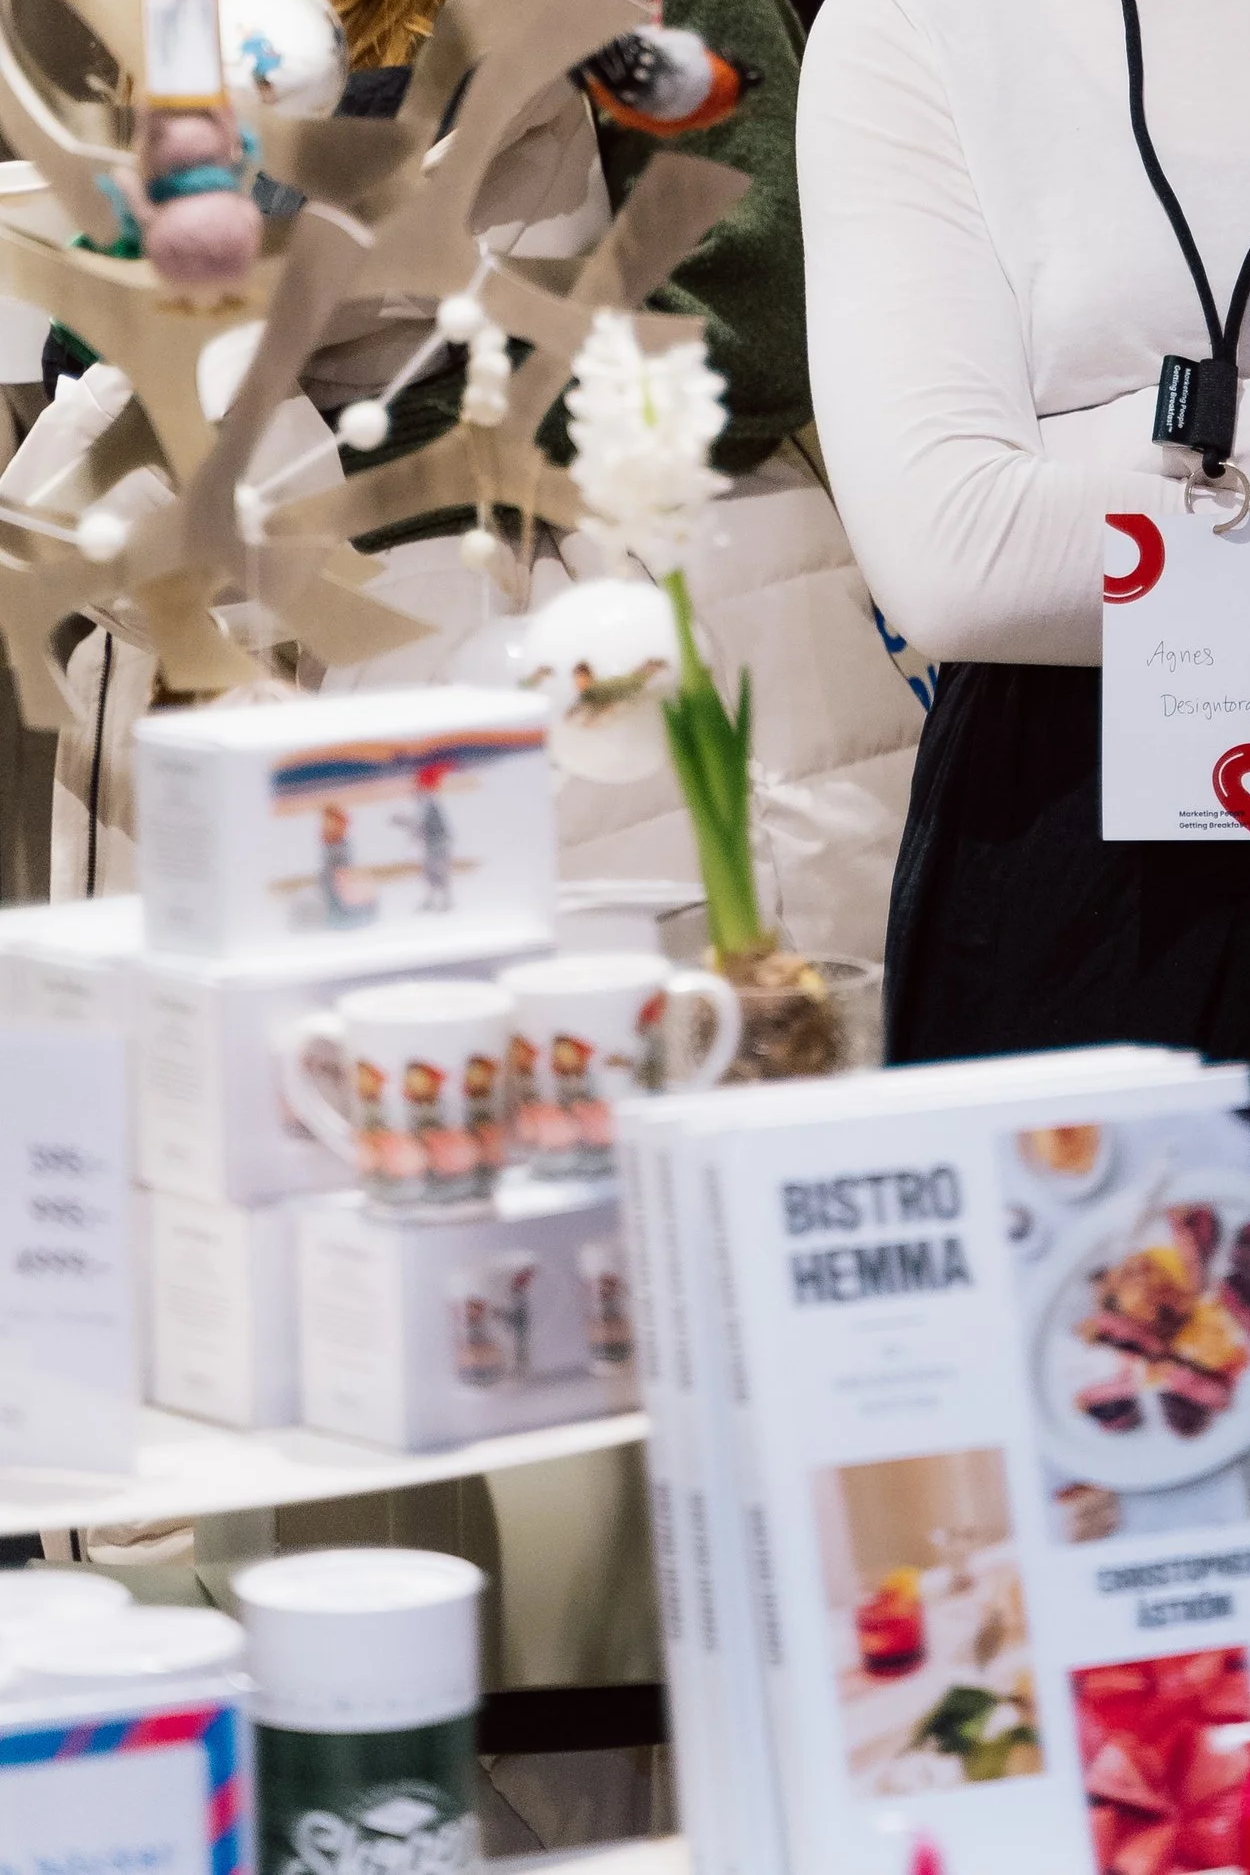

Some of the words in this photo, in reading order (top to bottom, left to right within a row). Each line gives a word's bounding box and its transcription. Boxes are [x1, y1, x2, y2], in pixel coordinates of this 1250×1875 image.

[1168, 364, 1181, 391] Getting
[1146, 640, 1214, 673] Agnes
[1178, 810, 1219, 819] Marketing
[1178, 822, 1208, 831] Getting
[782, 1163, 962, 1236] BISTRO
[790, 1236, 973, 1305] HEMMA
